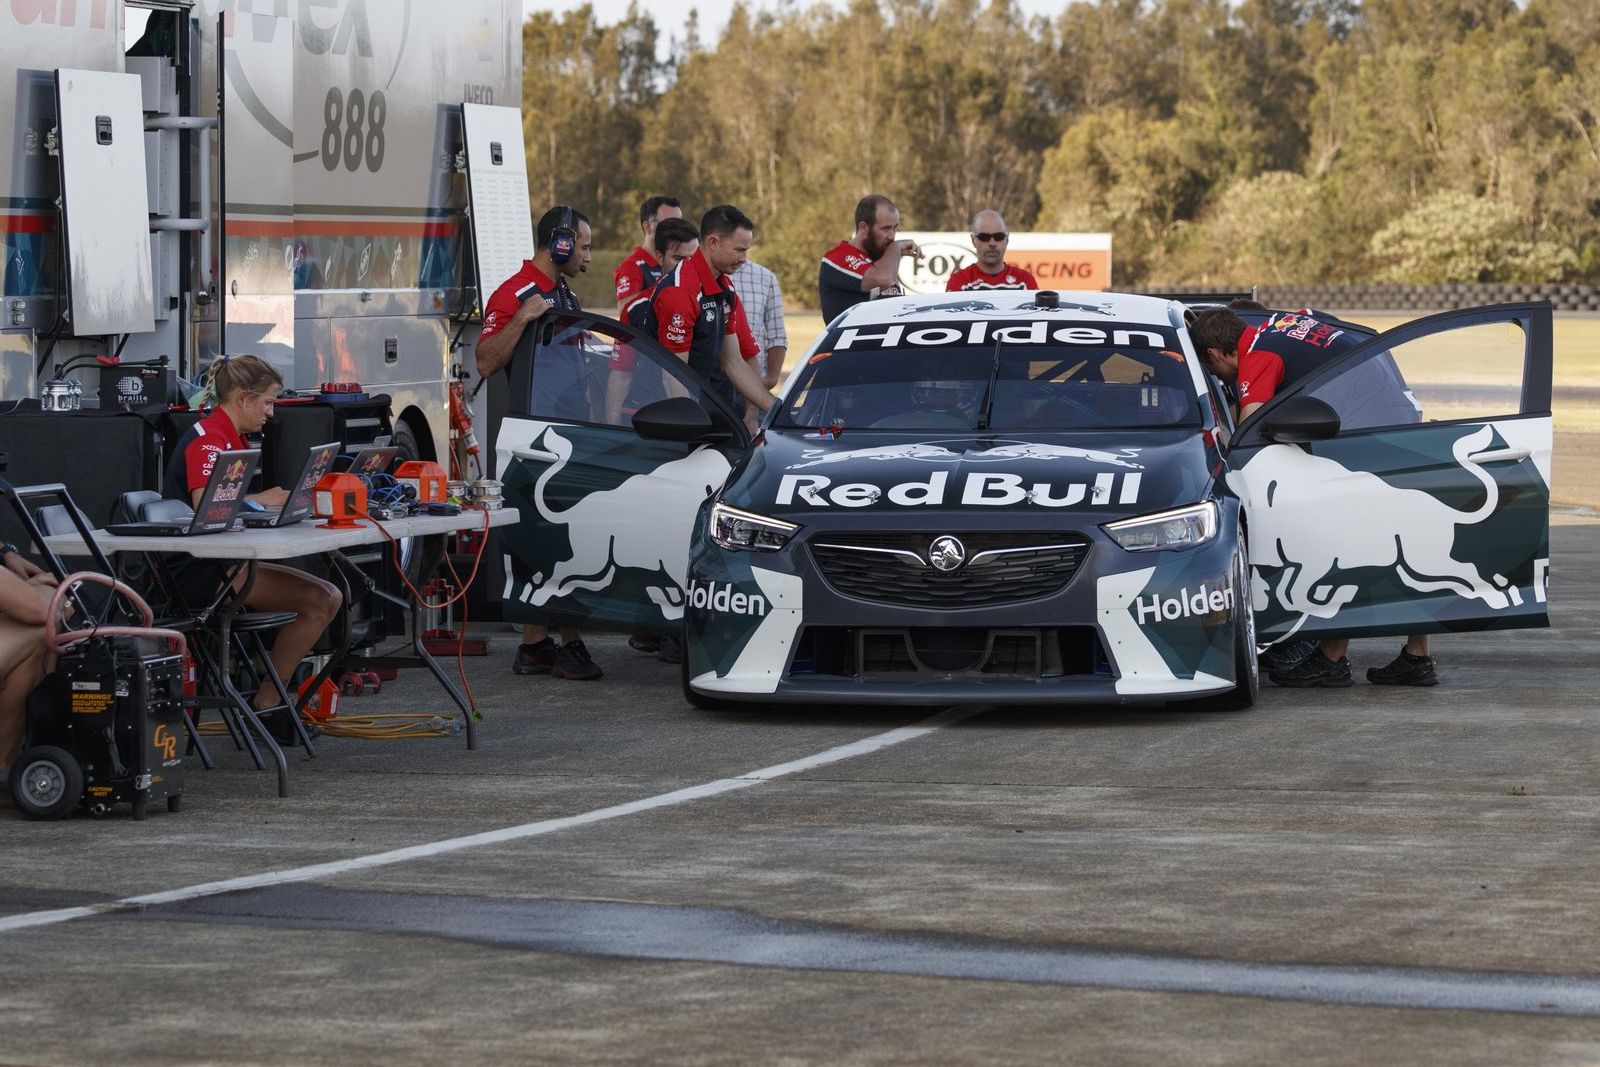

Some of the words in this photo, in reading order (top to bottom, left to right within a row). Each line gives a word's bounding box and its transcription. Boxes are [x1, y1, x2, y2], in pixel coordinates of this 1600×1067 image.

[321, 86, 387, 173] 888
[913, 255, 965, 276] FOX
[1008, 262, 1093, 279] ACING
[832, 321, 1166, 350] Holden
[775, 470, 949, 508] Red
[961, 472, 1142, 507] Bull
[685, 579, 764, 616] Holden
[1136, 584, 1235, 625] Holden
